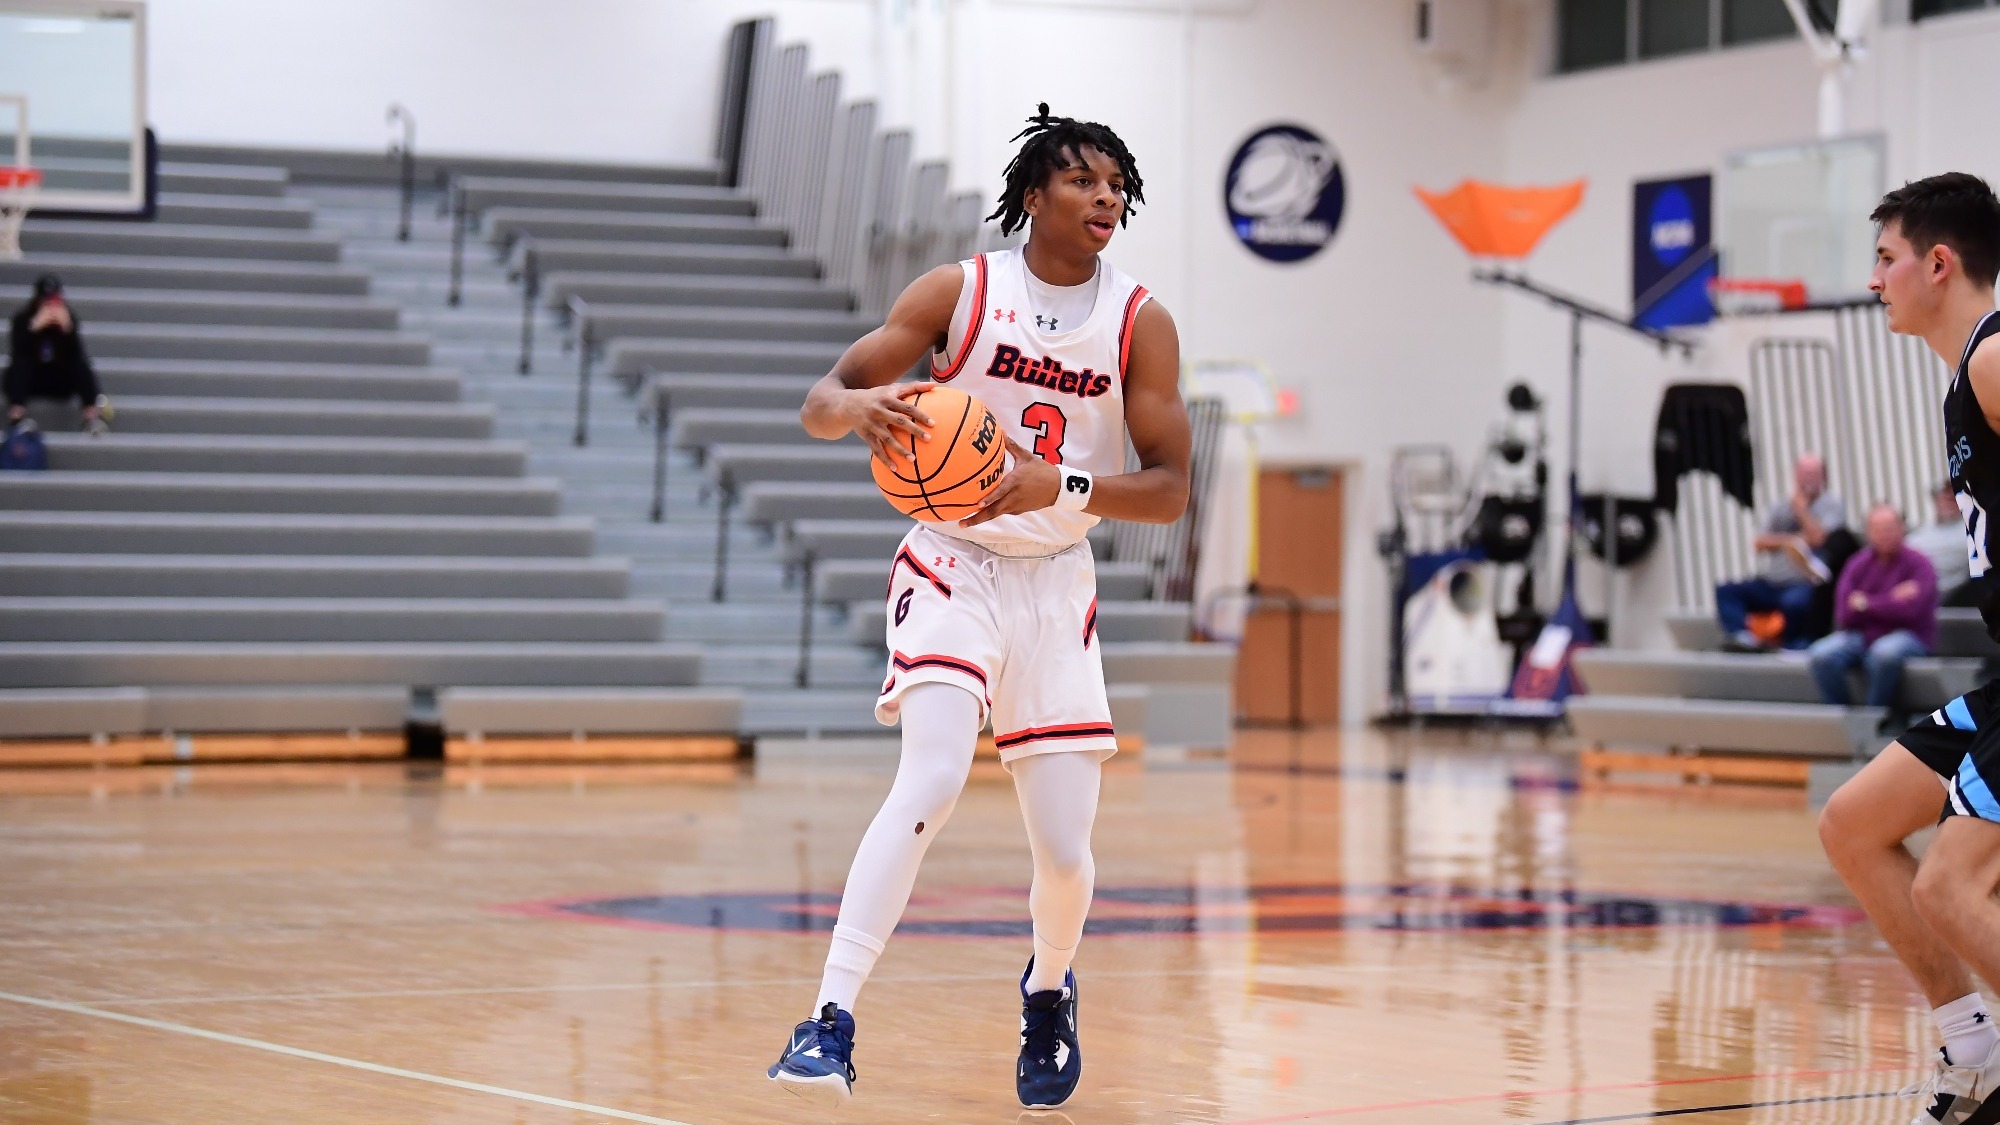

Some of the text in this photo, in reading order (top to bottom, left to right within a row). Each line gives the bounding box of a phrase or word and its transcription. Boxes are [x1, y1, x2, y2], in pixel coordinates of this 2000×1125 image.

[985, 342, 1112, 398] Bullets
[1021, 402, 1068, 467] 3
[1066, 474, 1090, 495] 3
[894, 587, 915, 627] G
